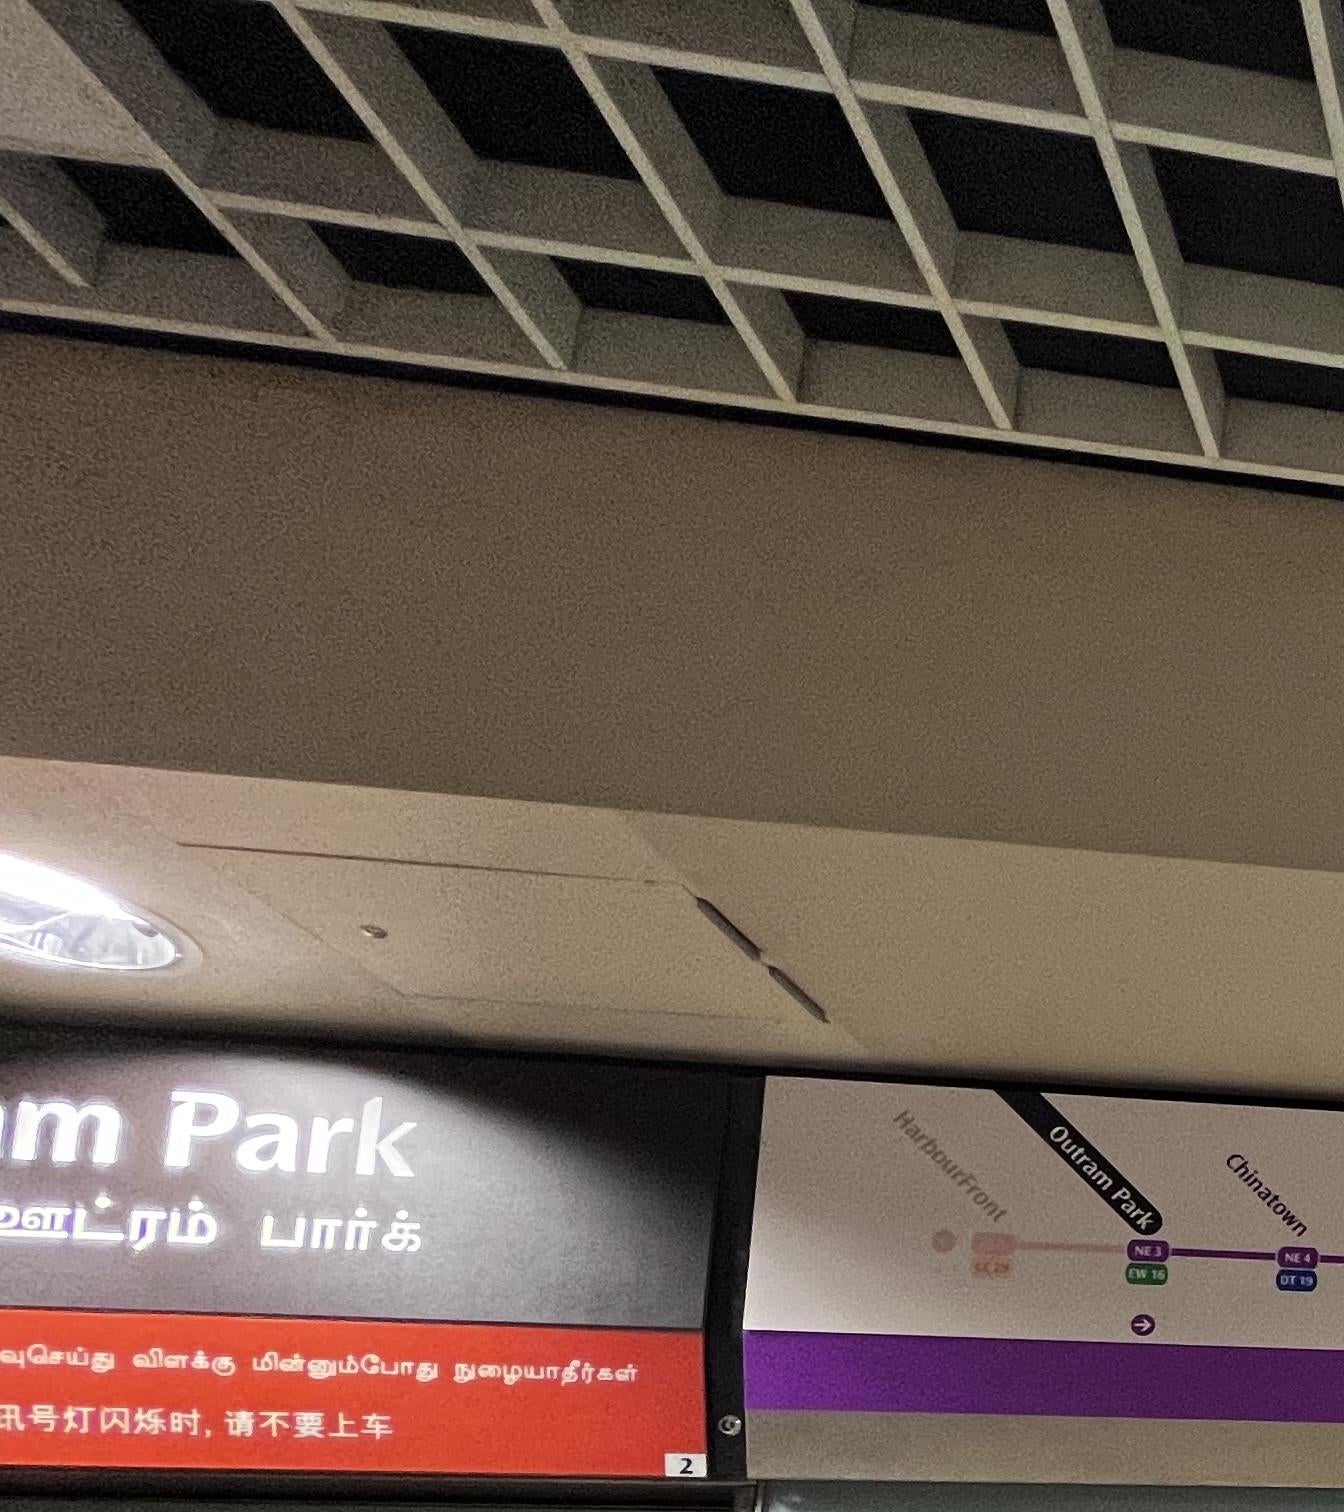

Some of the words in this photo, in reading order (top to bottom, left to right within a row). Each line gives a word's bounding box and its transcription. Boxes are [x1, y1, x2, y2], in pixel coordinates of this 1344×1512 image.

[163, 1088, 418, 1179] Park
[893, 1110, 1008, 1222] HarbourFront
[1049, 1125, 1114, 1191] Outram
[1111, 1186, 1155, 1231] Park
[1226, 1154, 1308, 1237] Chinatown
[259, 1206, 423, 1253] பார்க்
[679, 1457, 694, 1475] 2
